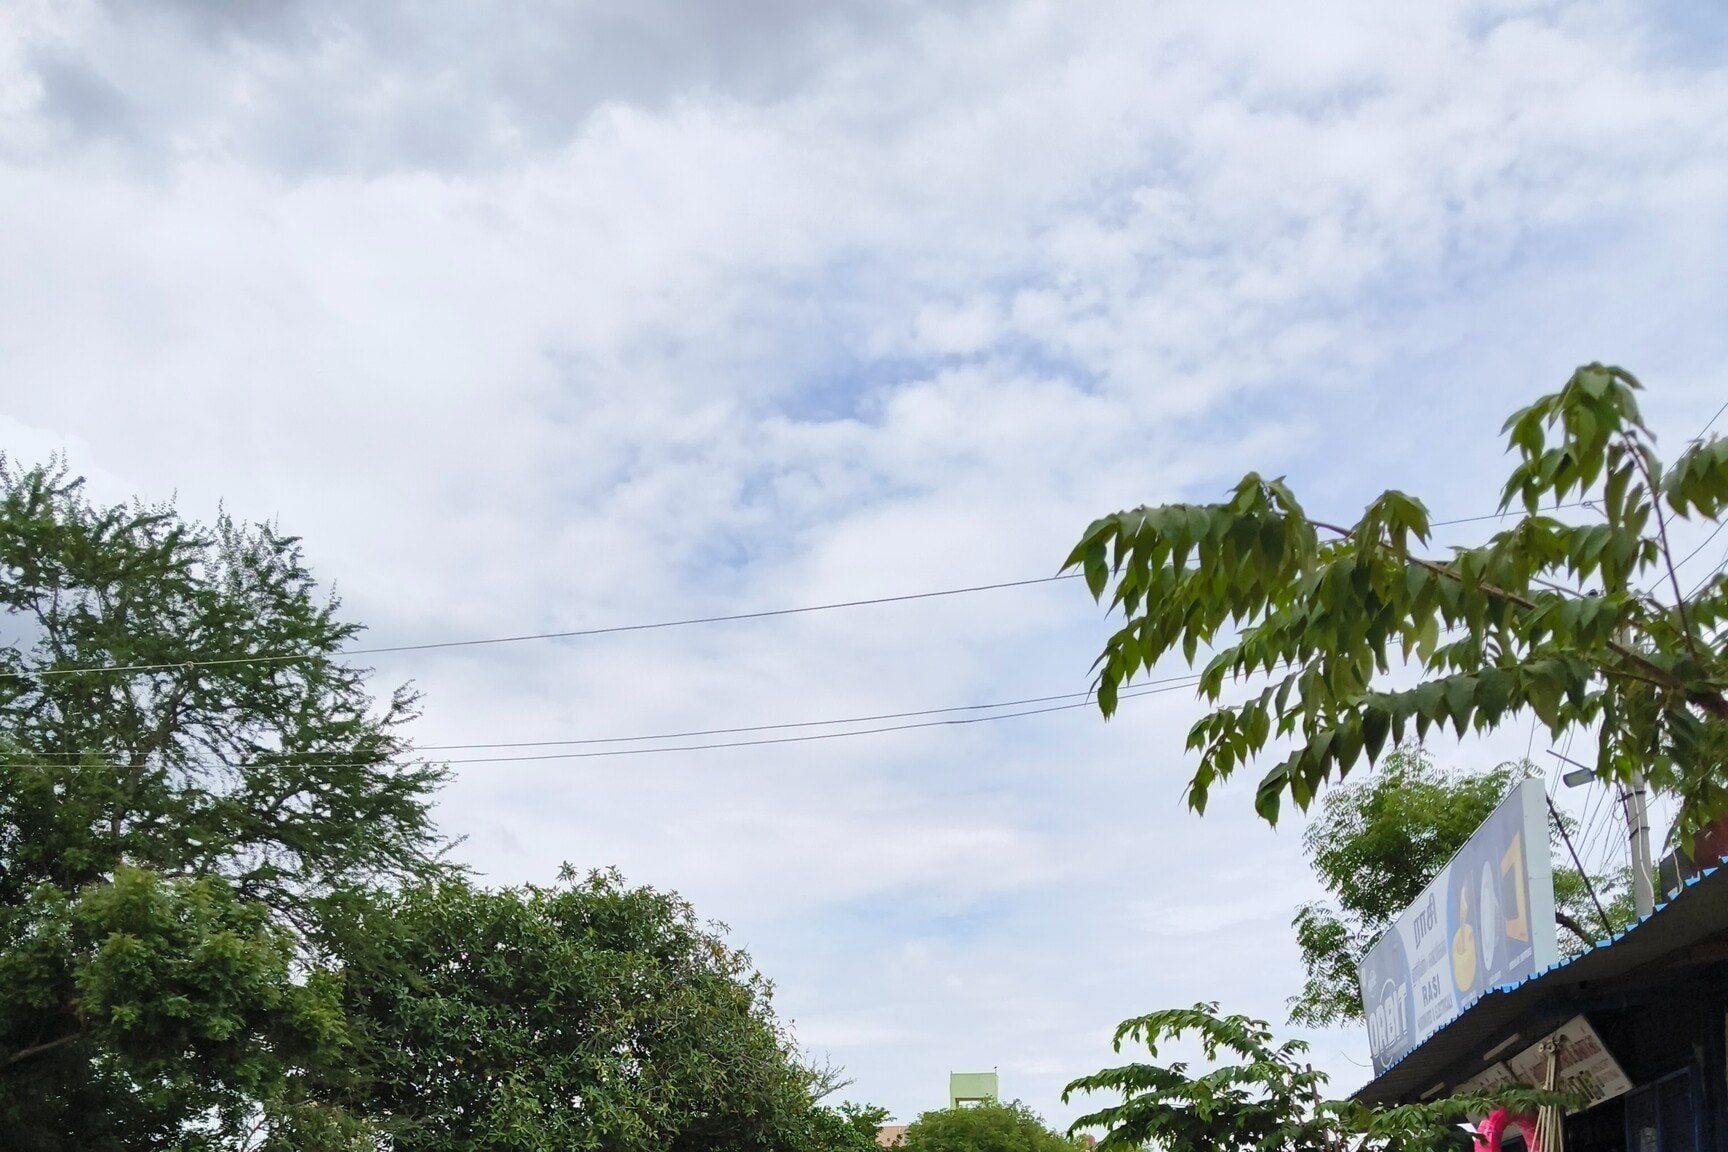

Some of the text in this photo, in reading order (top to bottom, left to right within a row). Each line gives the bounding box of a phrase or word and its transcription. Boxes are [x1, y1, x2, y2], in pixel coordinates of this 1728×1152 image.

[1412, 892, 1438, 950] ராசி
[1421, 973, 1441, 1008] RASI
[1369, 982, 1408, 1058] ORBIT
